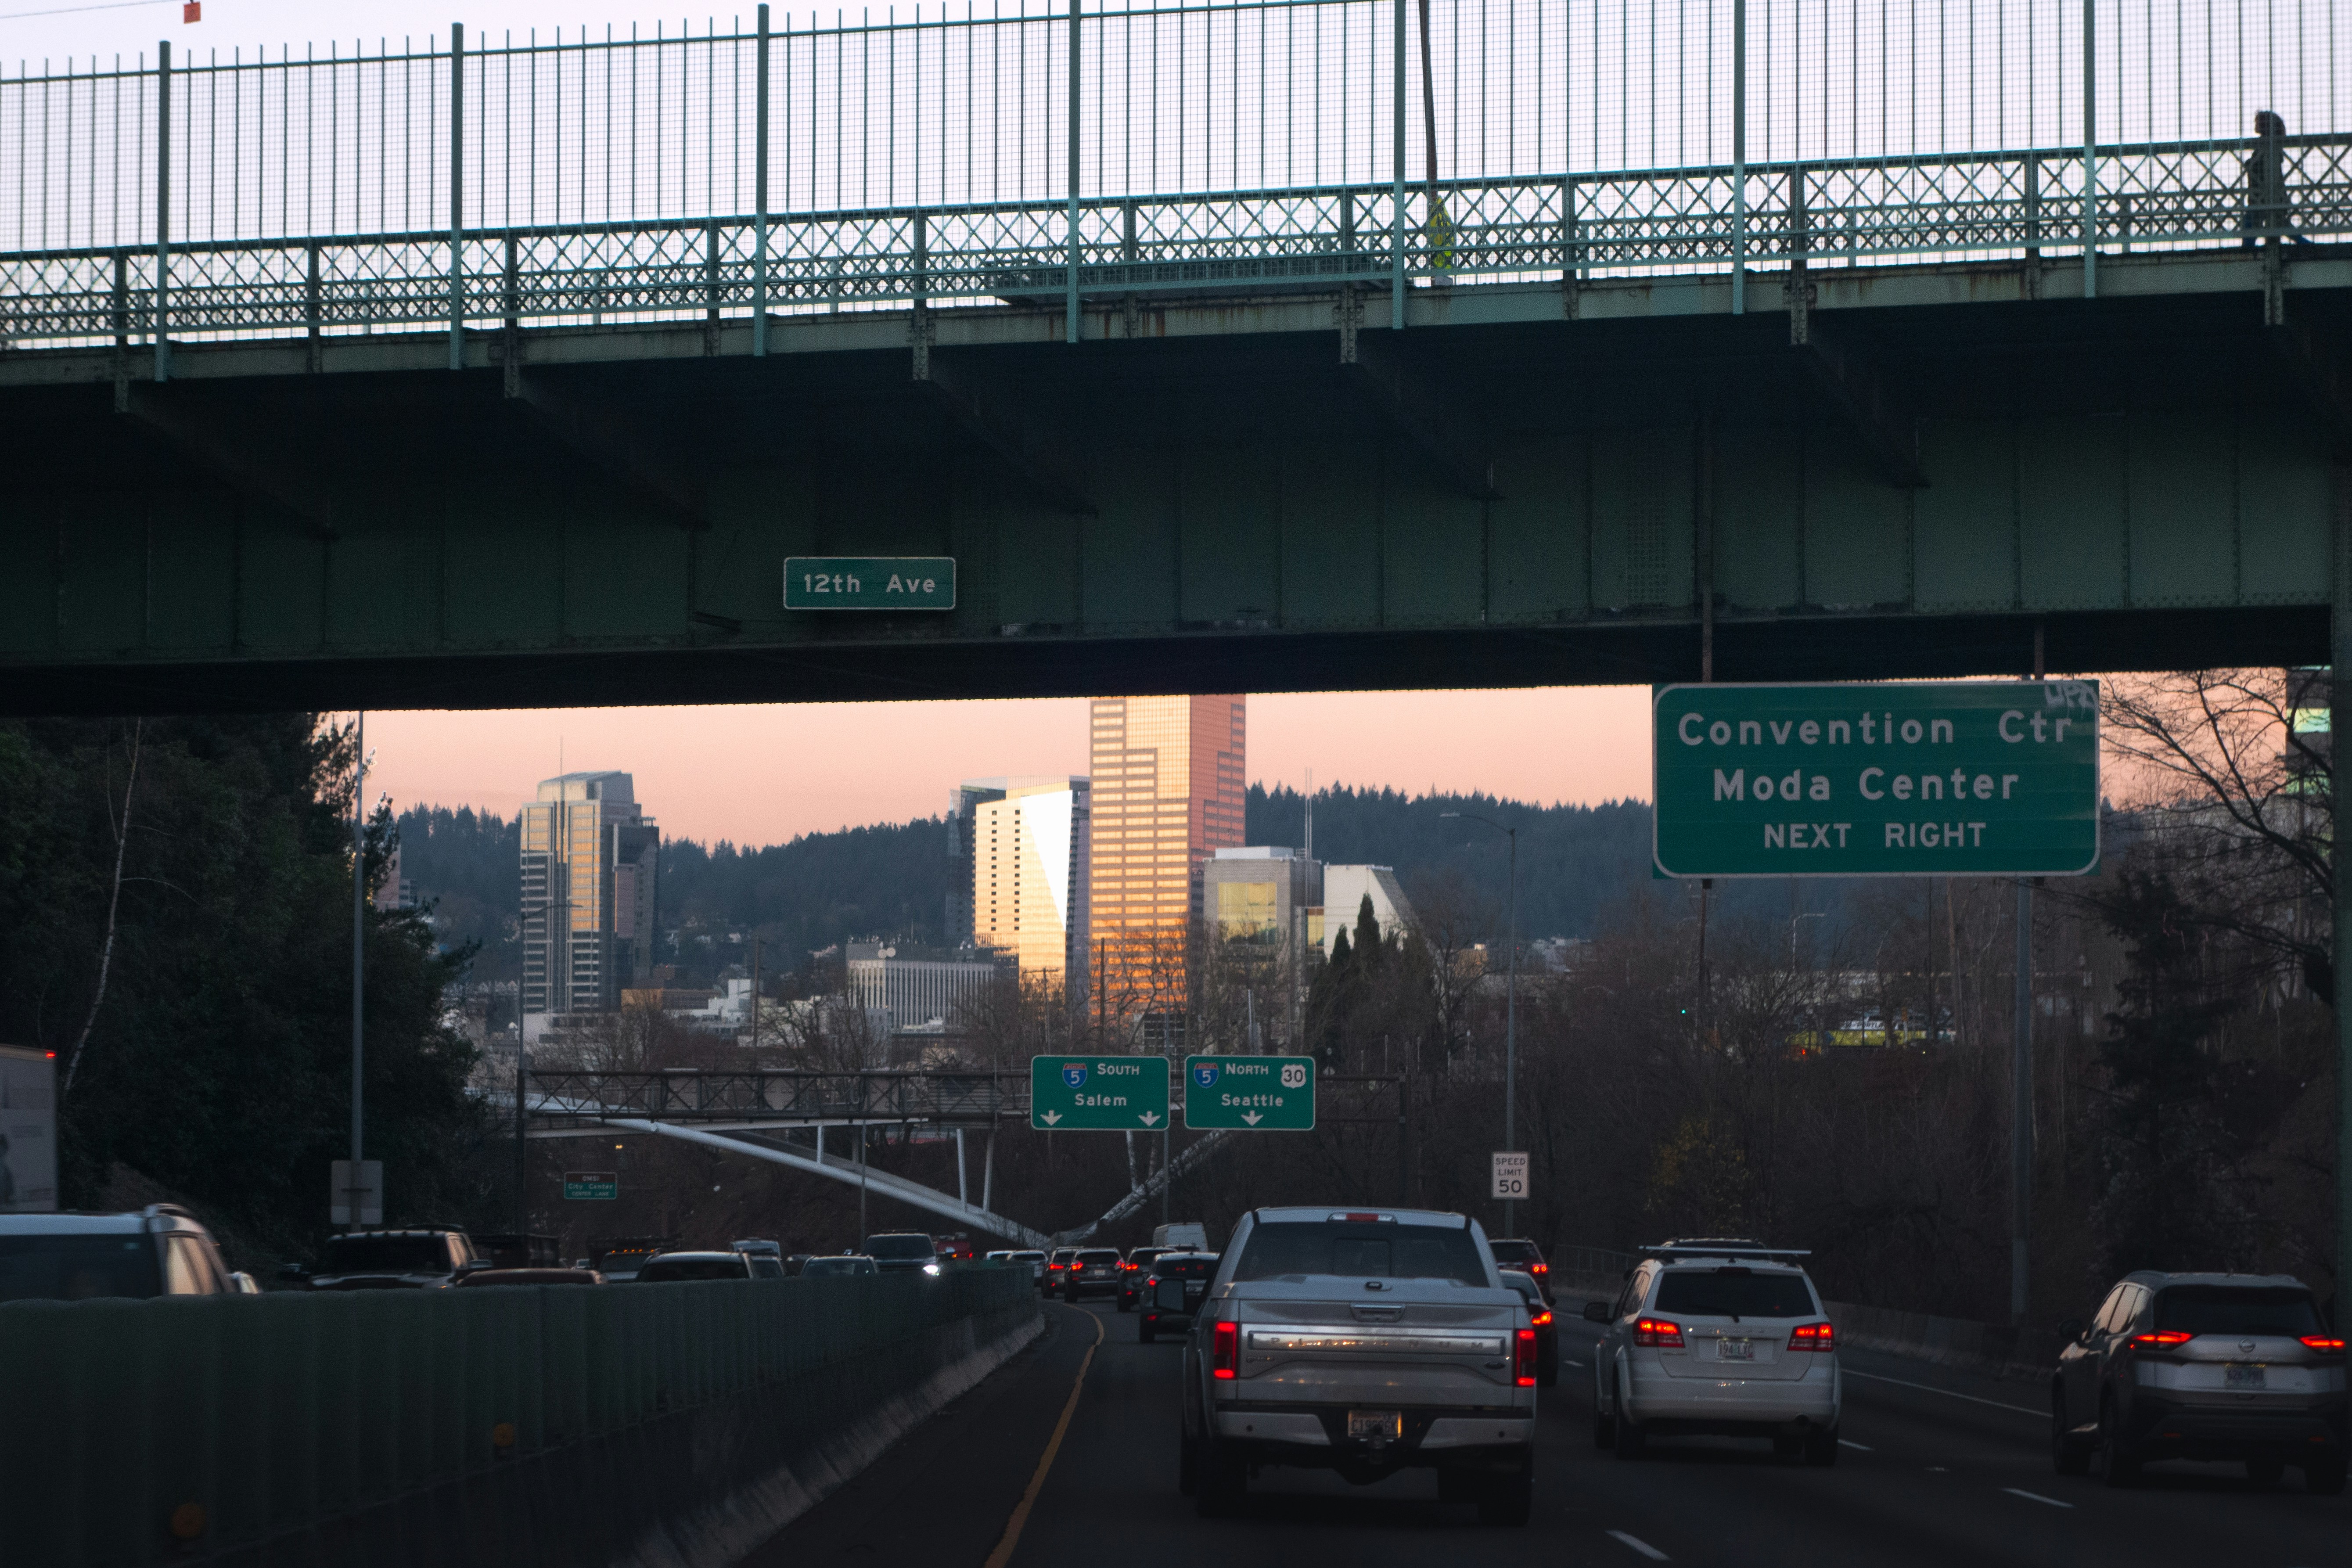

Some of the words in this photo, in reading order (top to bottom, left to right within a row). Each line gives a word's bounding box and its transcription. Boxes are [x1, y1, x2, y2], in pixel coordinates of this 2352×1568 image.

[805, 574, 860, 593] 12th
[886, 575, 935, 593] Ave
[1679, 712, 1953, 745] Convention
[1999, 710, 2072, 742] Ctr
[1714, 769, 1829, 801] Moda
[1859, 767, 2018, 800] Center
[1765, 824, 1851, 848] NEXT
[1885, 823, 1986, 847] RIGHT
[1071, 1070, 1080, 1084] 5
[1097, 1063, 1139, 1075] SOUTH
[1202, 1070, 1211, 1084] 5
[1226, 1063, 1268, 1075] NORTH
[1284, 1069, 1303, 1083] 30
[1075, 1093, 1126, 1106] Salem
[1222, 1093, 1283, 1106] Seattle
[1500, 1180, 1522, 1193] 50
